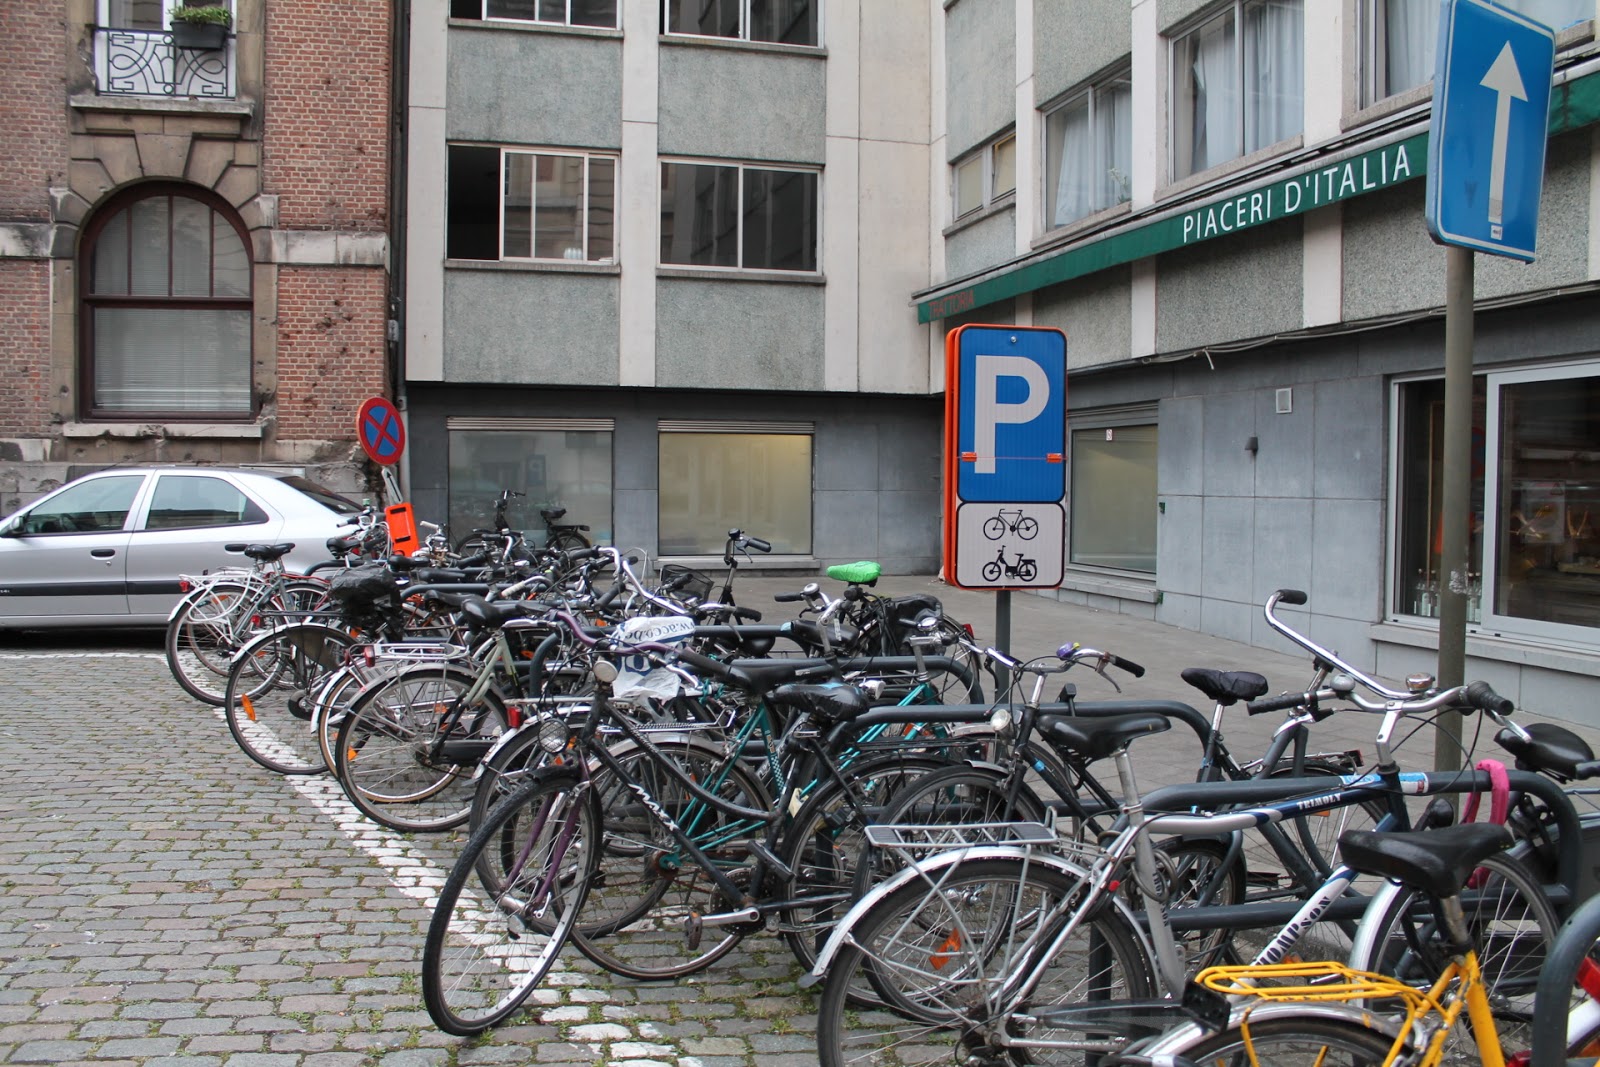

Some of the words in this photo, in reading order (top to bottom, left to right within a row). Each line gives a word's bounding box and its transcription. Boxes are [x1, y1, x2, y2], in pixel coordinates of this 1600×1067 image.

[1183, 189, 1271, 243] PIACERI
[1285, 144, 1411, 213] D'ITALIA
[929, 289, 975, 319] TRATTORIA
[974, 355, 1050, 474] P
[1296, 792, 1341, 810] TRIMOLY
